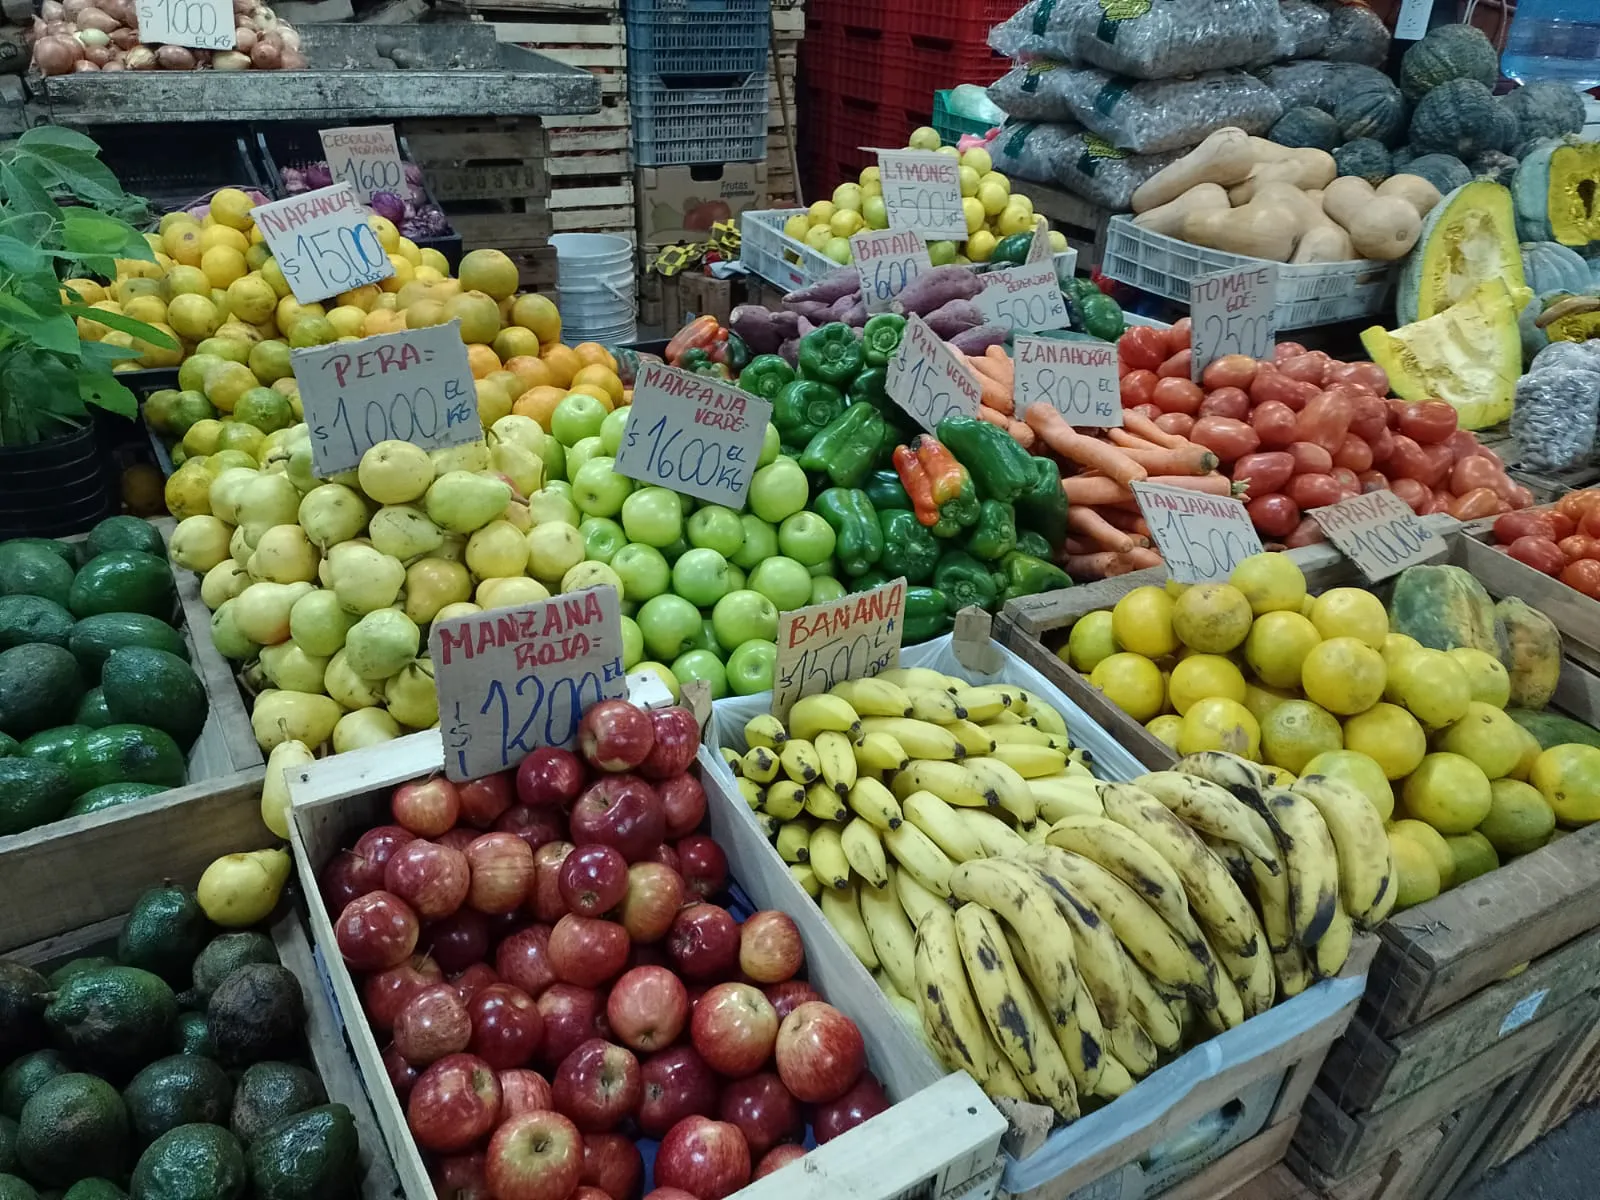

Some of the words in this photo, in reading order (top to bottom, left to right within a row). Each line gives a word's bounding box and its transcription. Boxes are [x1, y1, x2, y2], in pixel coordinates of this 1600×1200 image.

[195, 36, 213, 47] EL
[213, 35, 231, 48] KG
[720, 181, 749, 192] Frutas
[348, 278, 363, 288] LA
[1193, 267, 1269, 303] TOMATE
[444, 380, 466, 400] EL
[644, 368, 747, 415] MANZANA
[1098, 378, 1114, 392] EL
[447, 400, 472, 428] KG
[1095, 400, 1113, 416] KG
[727, 445, 747, 463] EL
[716, 467, 744, 492] KG
[788, 583, 902, 649] BANANA
[438, 592, 603, 665] MANZANA
[602, 656, 624, 682] EL
